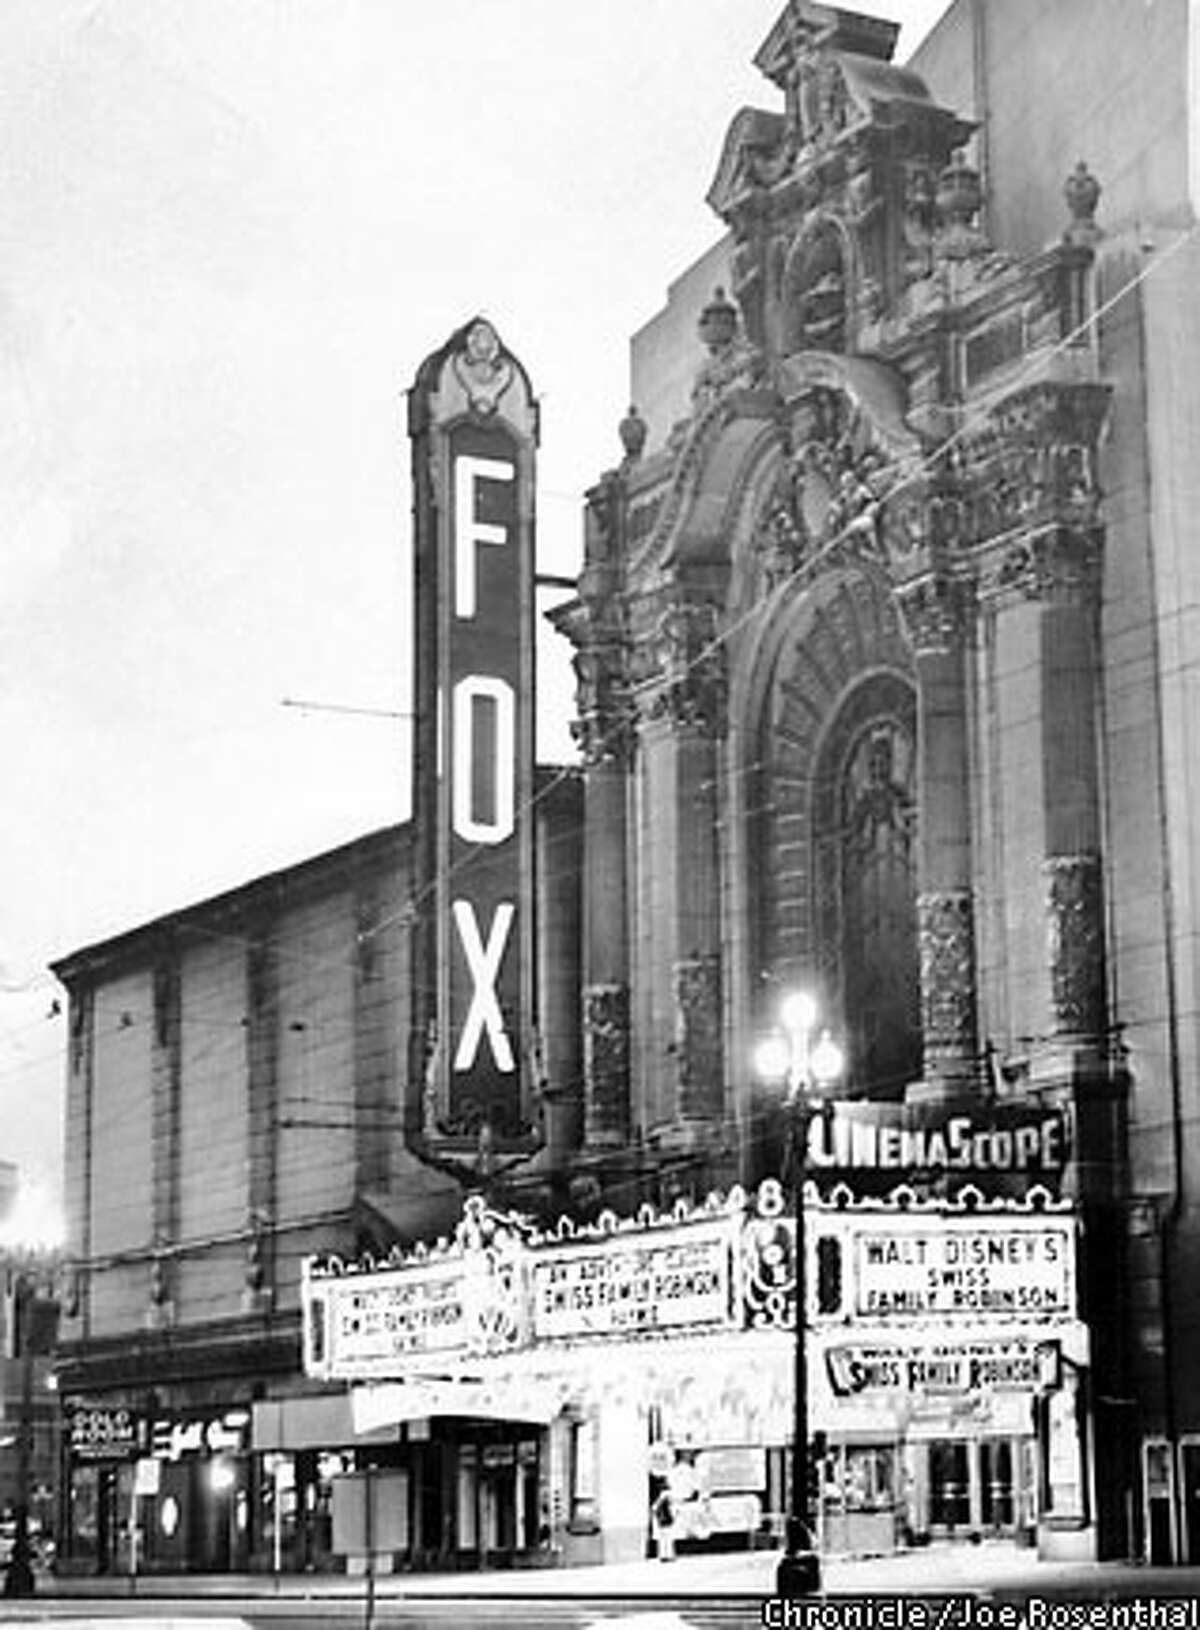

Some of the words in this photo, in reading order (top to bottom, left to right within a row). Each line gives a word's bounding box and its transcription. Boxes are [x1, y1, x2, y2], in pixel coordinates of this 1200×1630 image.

[452, 455, 515, 1073] FOX
[864, 1240, 927, 1264] WALT
[927, 1267, 990, 1287] SWISS
[867, 1289, 938, 1310] FAMILY
[953, 1286, 1058, 1308] ROBINSON
